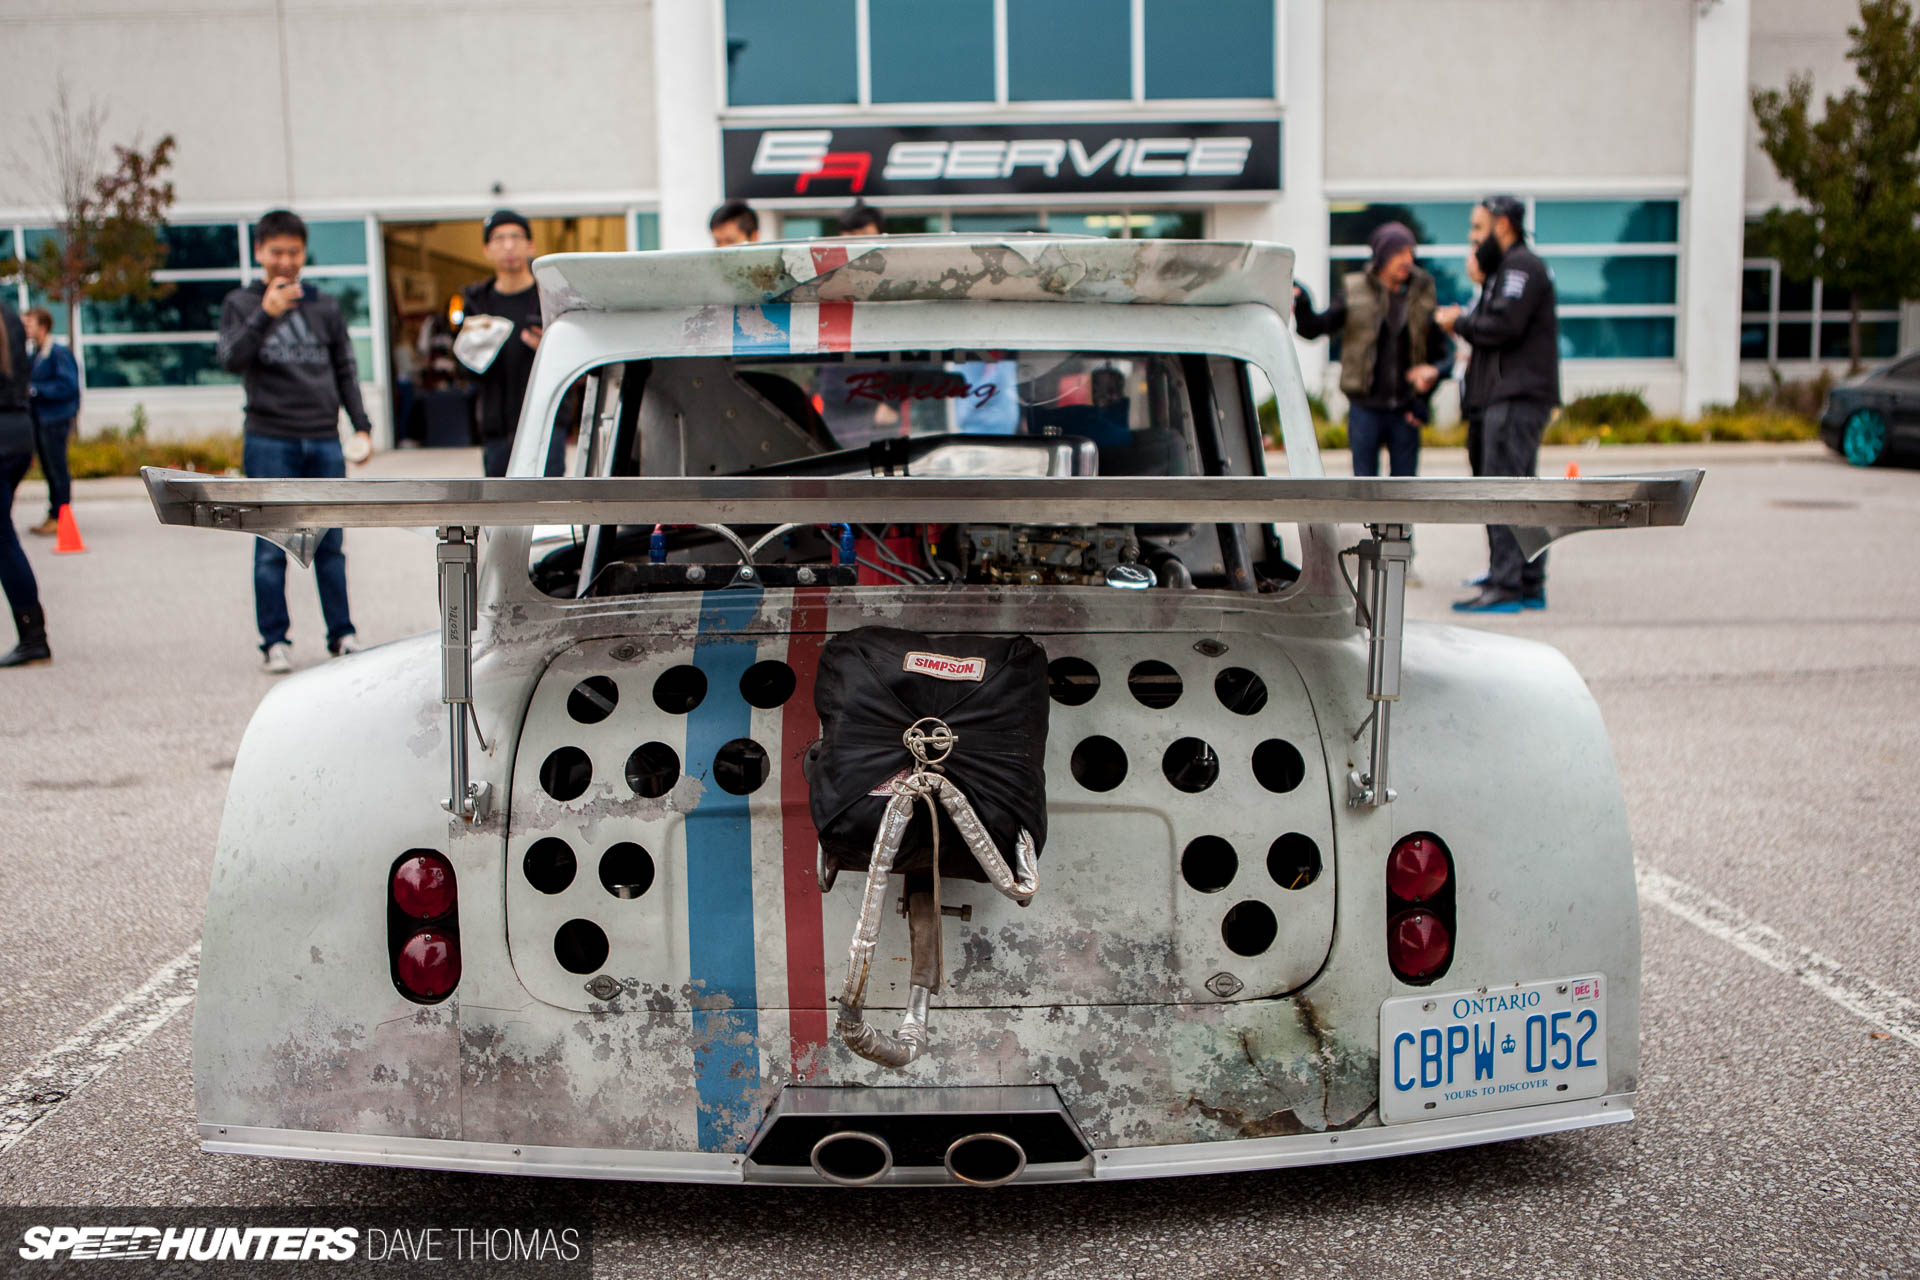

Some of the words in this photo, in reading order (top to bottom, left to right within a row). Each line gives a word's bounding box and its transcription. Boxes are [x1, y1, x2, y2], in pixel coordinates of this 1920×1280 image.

[882, 137, 1253, 180] SERVICE
[846, 371, 1000, 409] Racing
[914, 656, 975, 675] SIMPSON
[1575, 984, 1590, 996] DEC
[1453, 991, 1541, 1019] ONTARIO
[1393, 1021, 1496, 1093] CBPW
[1525, 1009, 1598, 1074] 052
[1444, 1088, 1478, 1101] YOURS
[1482, 1086, 1496, 1096] TO
[1498, 1078, 1549, 1094] DISCOVER
